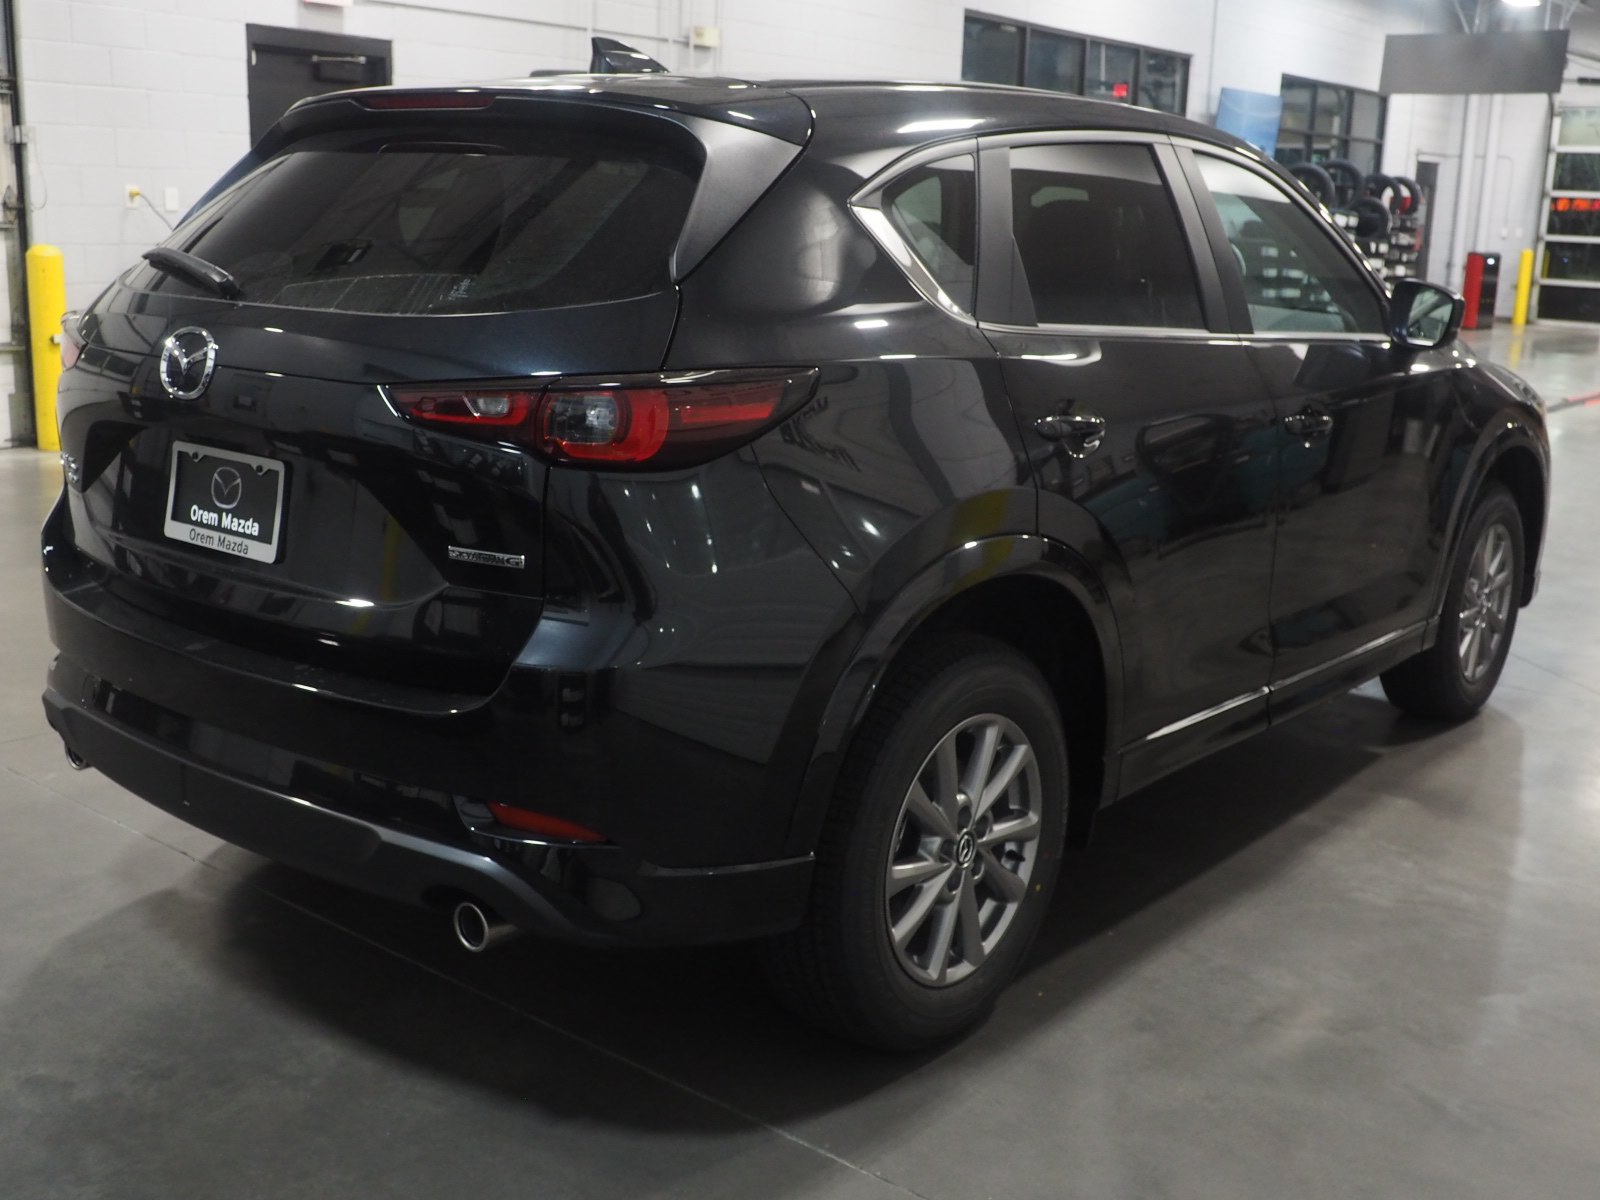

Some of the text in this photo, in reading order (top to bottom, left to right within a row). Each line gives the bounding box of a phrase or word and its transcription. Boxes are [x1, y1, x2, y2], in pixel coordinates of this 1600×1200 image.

[190, 504, 260, 536] Orem Mazda
[189, 528, 249, 555] Orem Mazda
